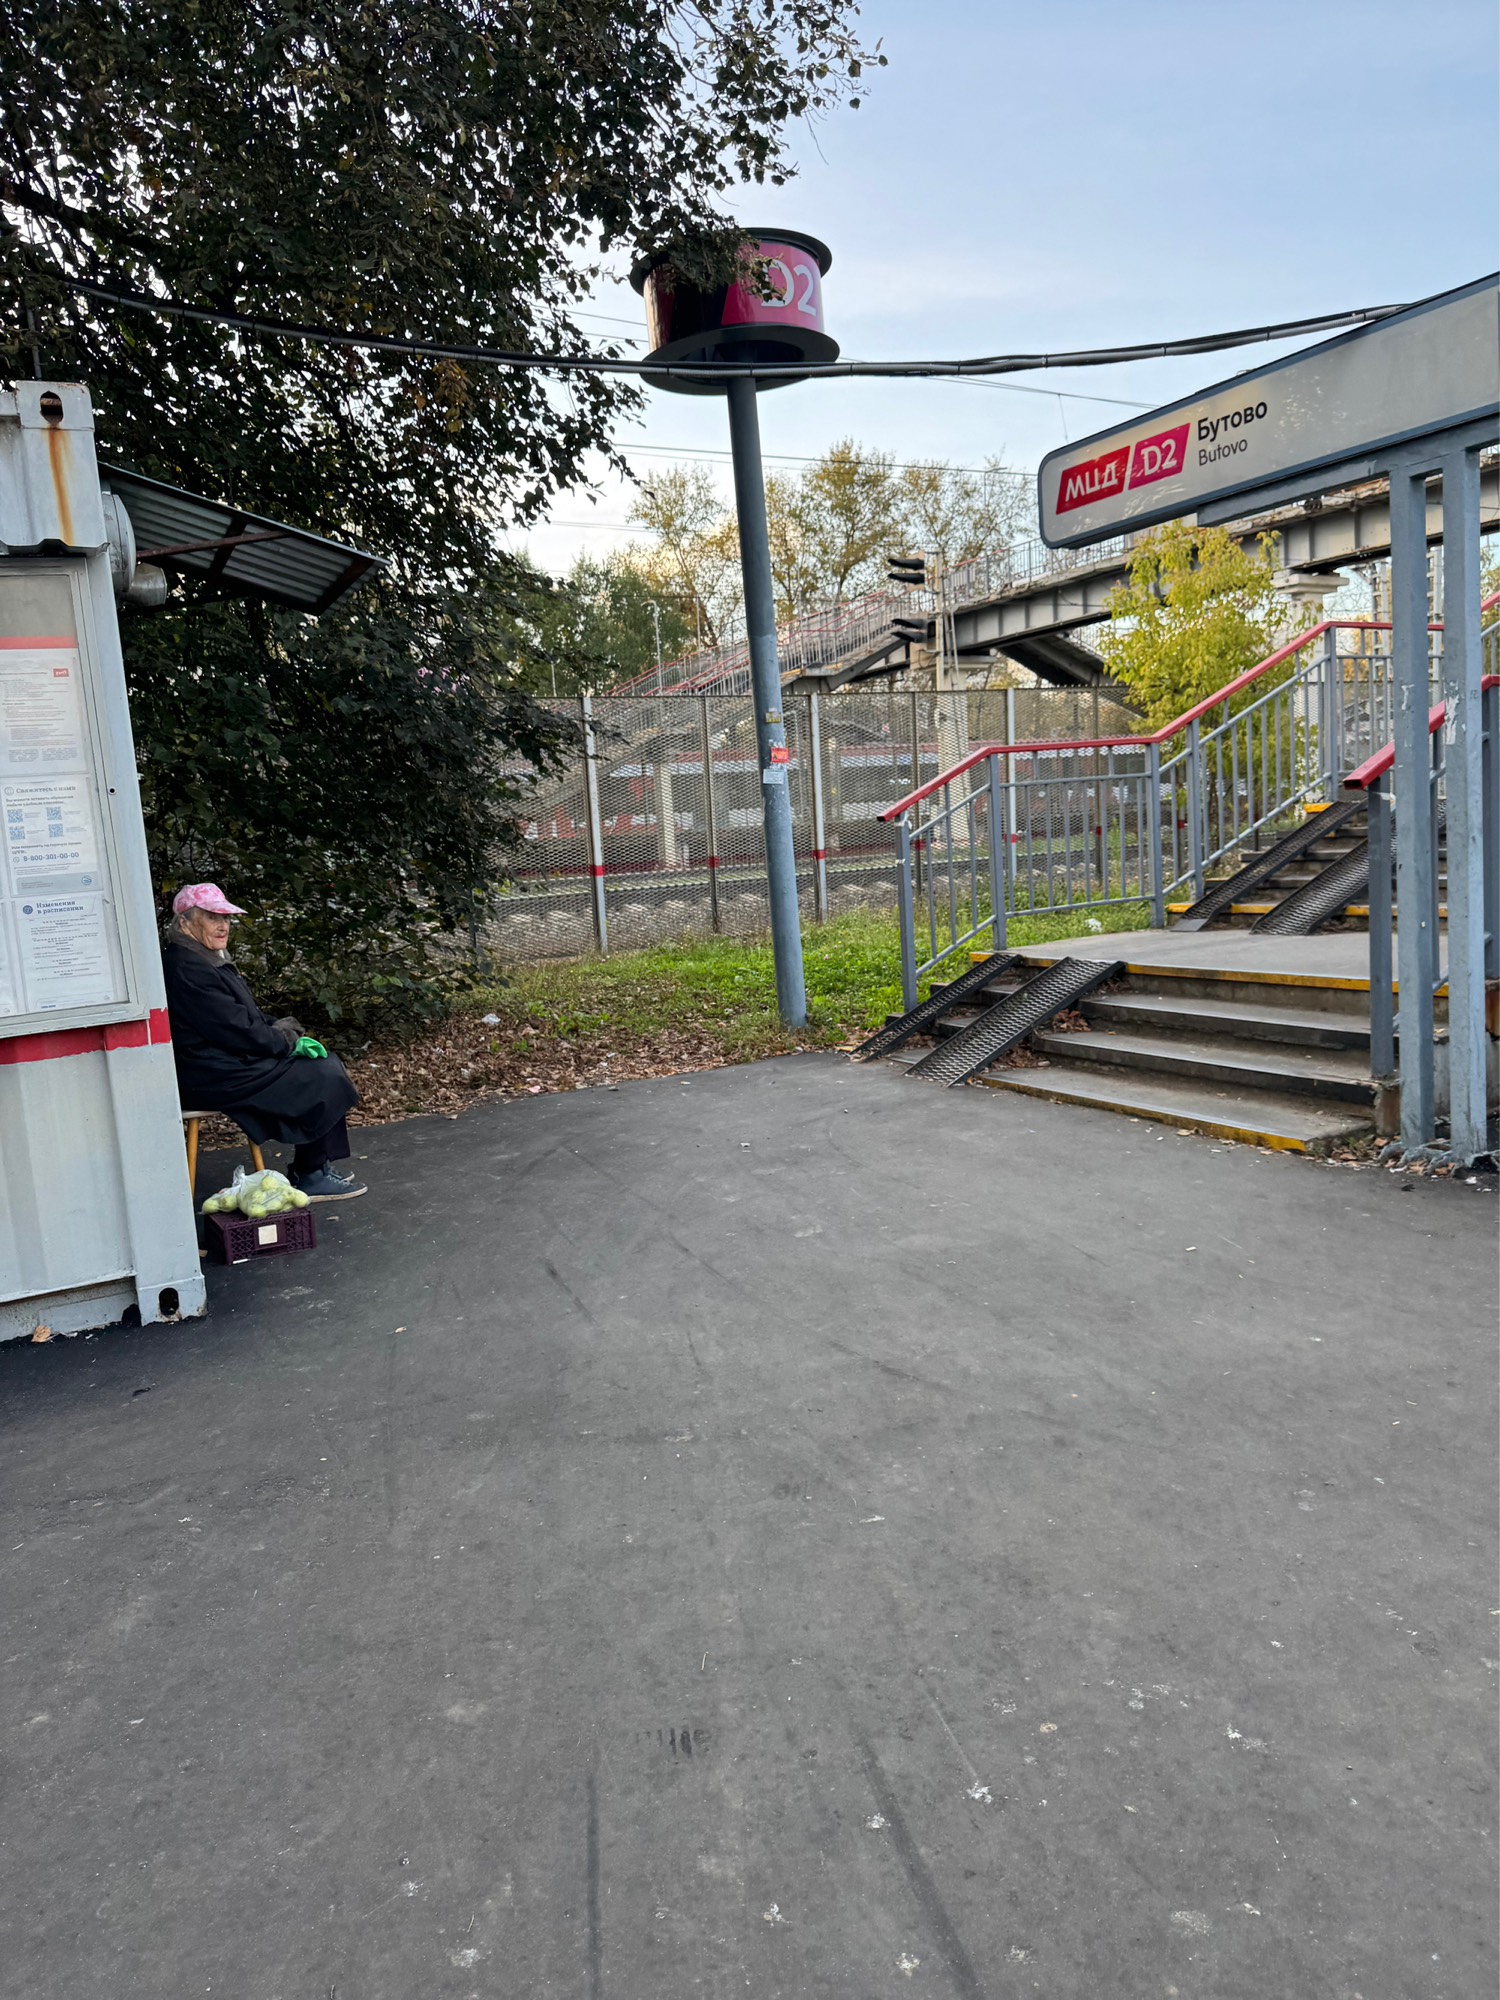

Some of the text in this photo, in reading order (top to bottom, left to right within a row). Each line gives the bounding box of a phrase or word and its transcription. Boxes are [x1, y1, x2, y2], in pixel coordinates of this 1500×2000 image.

[761, 258, 816, 316] D2
[1197, 402, 1268, 442] Бутово
[1141, 438, 1177, 476] D2
[1199, 439, 1248, 467] Butovo
[1065, 460, 1119, 502] МЦД
[16, 786, 53, 794] Свяжитесь
[43, 906, 84, 915] расписании
